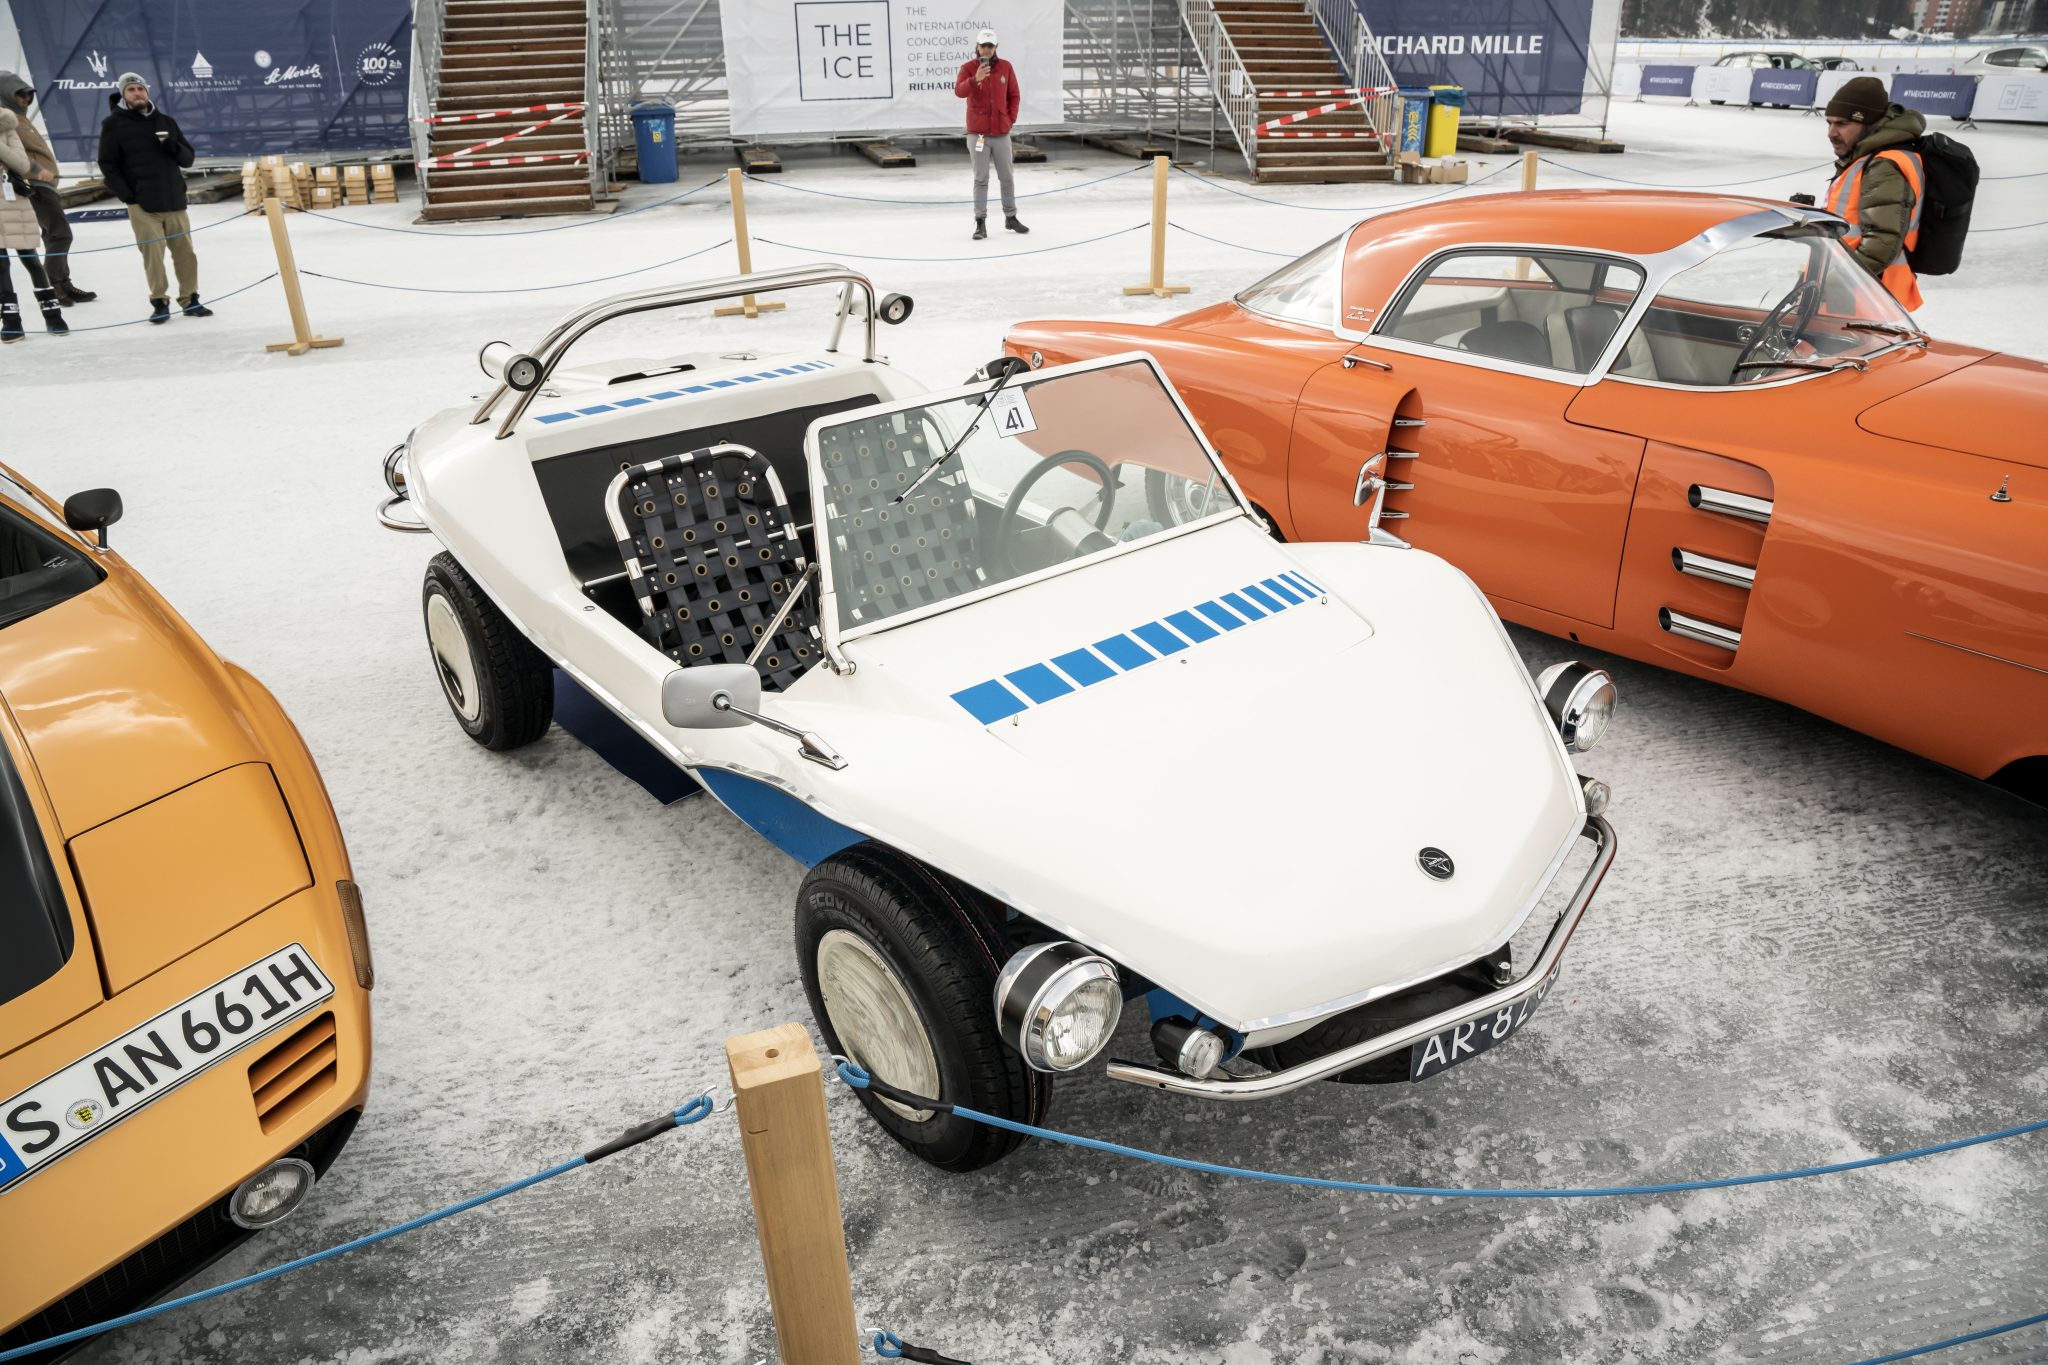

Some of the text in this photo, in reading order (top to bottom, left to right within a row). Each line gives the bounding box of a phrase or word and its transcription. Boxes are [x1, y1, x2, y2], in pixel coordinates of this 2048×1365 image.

[905, 7, 927, 16] THE
[905, 21, 994, 31] INTERNATIONAL
[815, 24, 872, 47] THE
[906, 36, 969, 47] CONCOURS
[1360, 35, 1543, 55] RICHARD MILLE
[362, 57, 388, 71] 100
[907, 51, 978, 62] OF ELEGANC
[264, 63, 322, 85] St Moritz
[823, 55, 874, 79] ICE
[908, 66, 961, 77] ST. MORIT
[1006, 407, 1025, 430] 41
[6, 952, 323, 1154] S AN 661H
